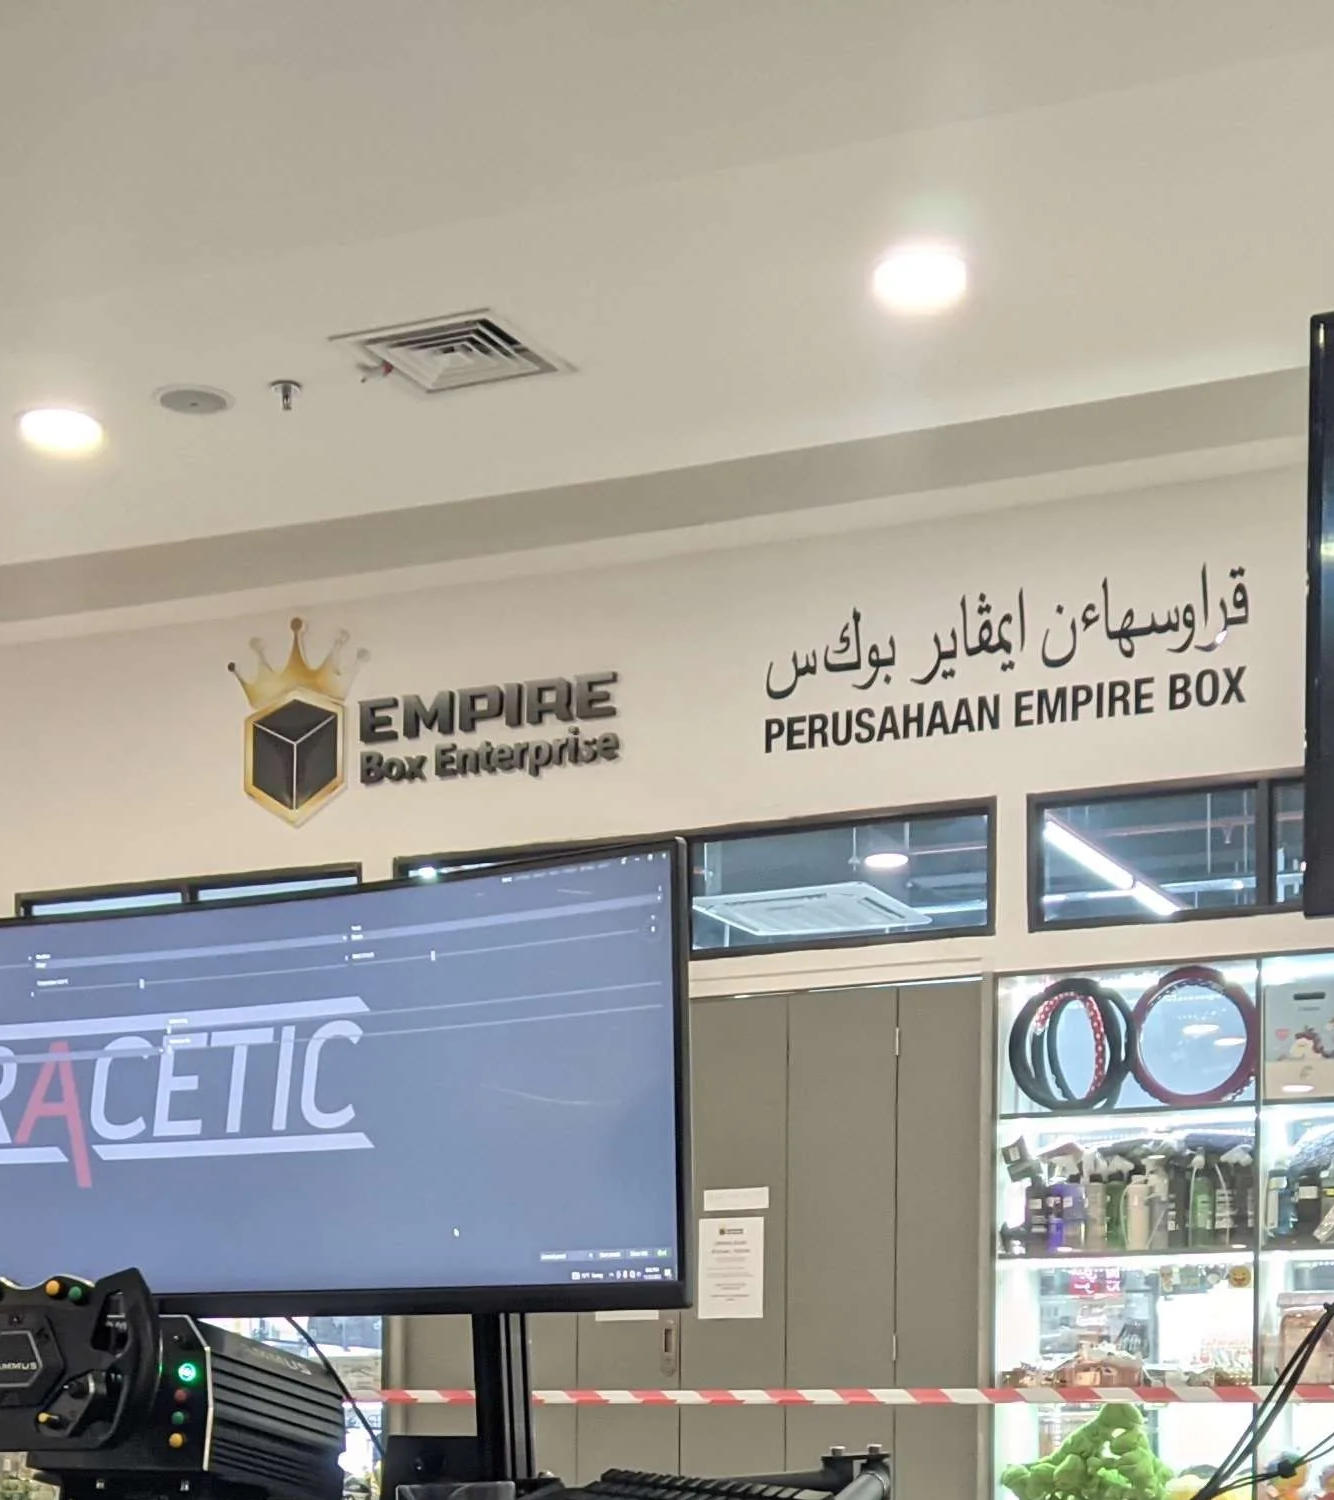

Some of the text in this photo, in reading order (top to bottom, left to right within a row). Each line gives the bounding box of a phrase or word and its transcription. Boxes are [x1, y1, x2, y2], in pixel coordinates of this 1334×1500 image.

[358, 671, 618, 745] EMPIRE
[764, 666, 1247, 754] PERUSAHAAN EMPIRE BOX
[359, 726, 621, 786] Box Enterprise
